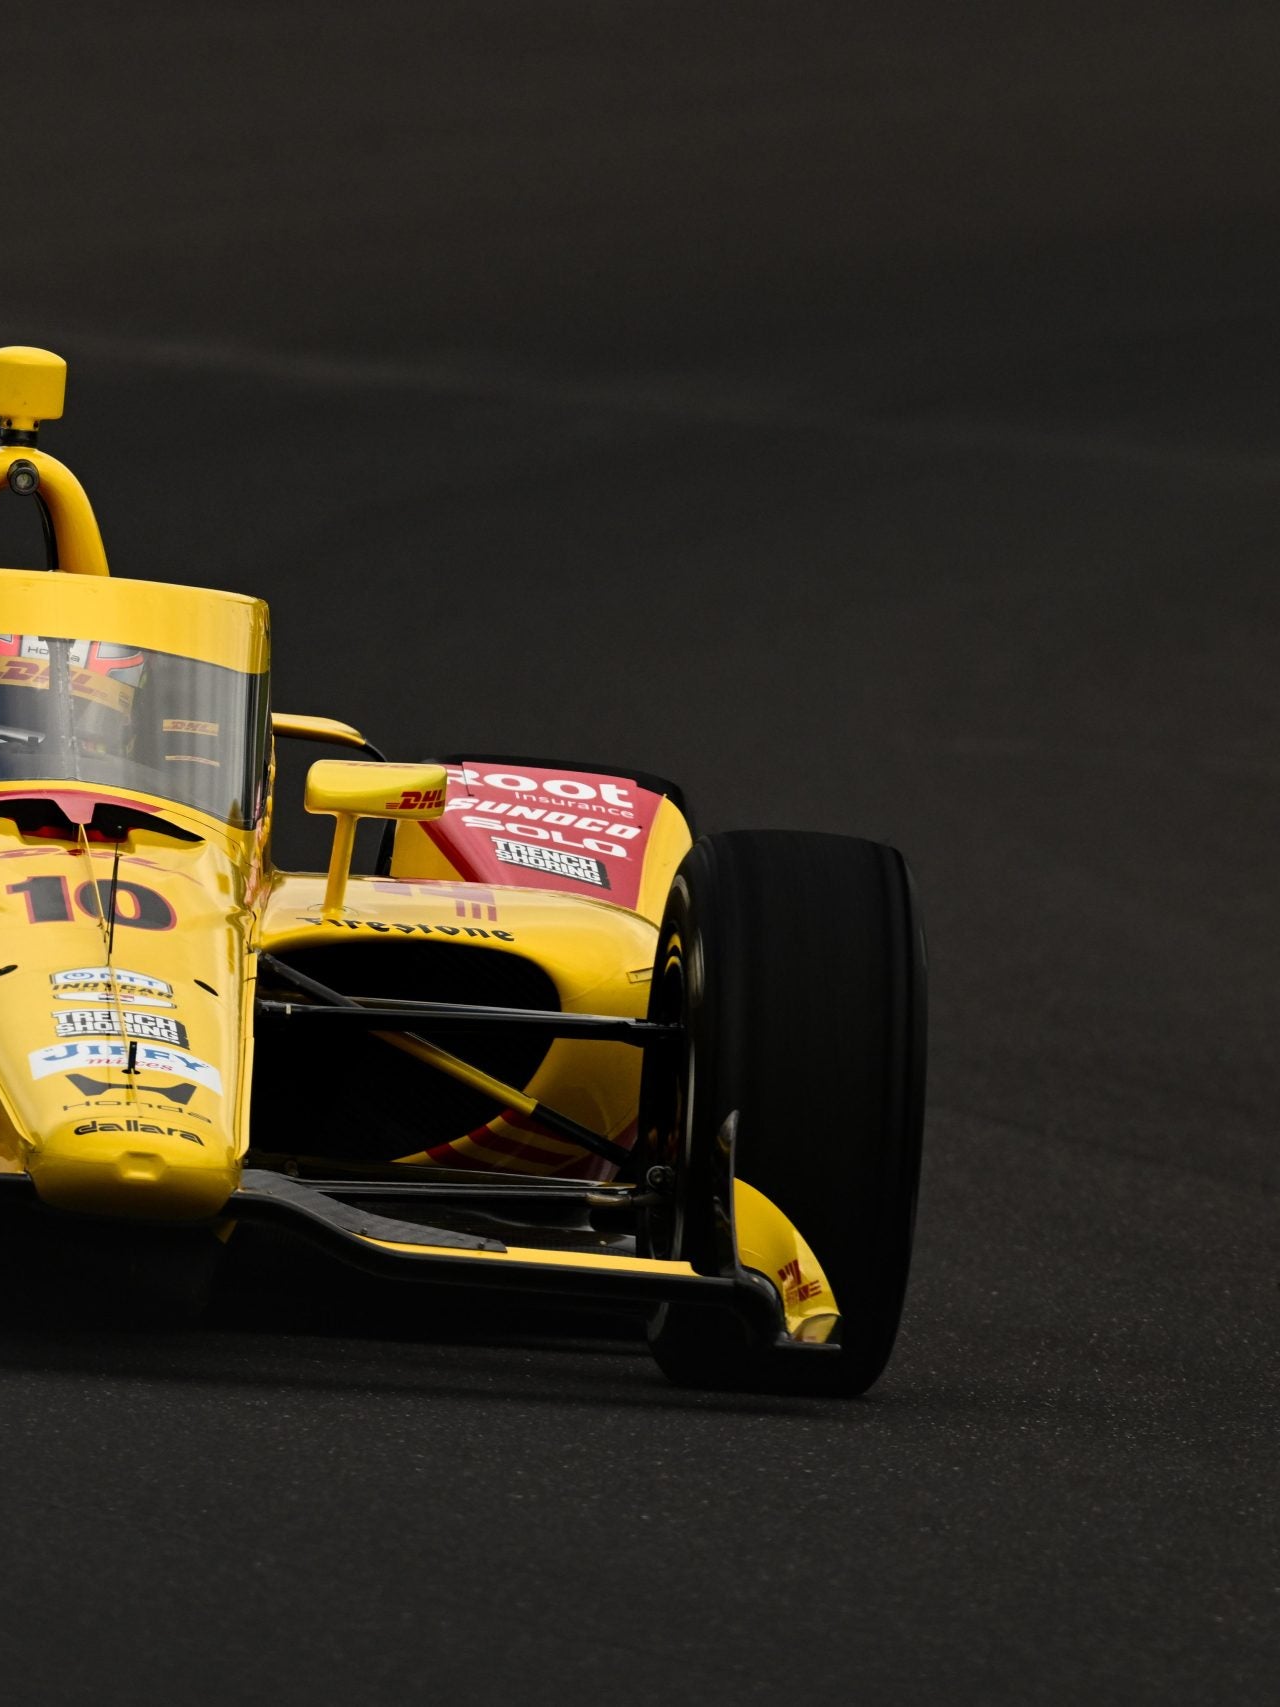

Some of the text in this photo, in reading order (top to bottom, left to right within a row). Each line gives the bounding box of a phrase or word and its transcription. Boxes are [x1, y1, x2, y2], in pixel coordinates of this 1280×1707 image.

[399, 789, 445, 810] DHL
[515, 791, 635, 819] Insurance
[445, 797, 641, 840] SUNOCO
[461, 815, 628, 859] SOLO
[494, 839, 600, 873] TRENCH
[495, 849, 602, 882] SHORING
[5, 875, 178, 931] 10
[296, 917, 515, 942] Firestone
[52, 982, 173, 999] INDYCAR
[100, 973, 159, 987] NTT
[54, 1011, 178, 1033] TRENCH
[55, 1020, 181, 1041] SHORING
[42, 1043, 206, 1072] JIFFY
[74, 1119, 205, 1147] dallara
